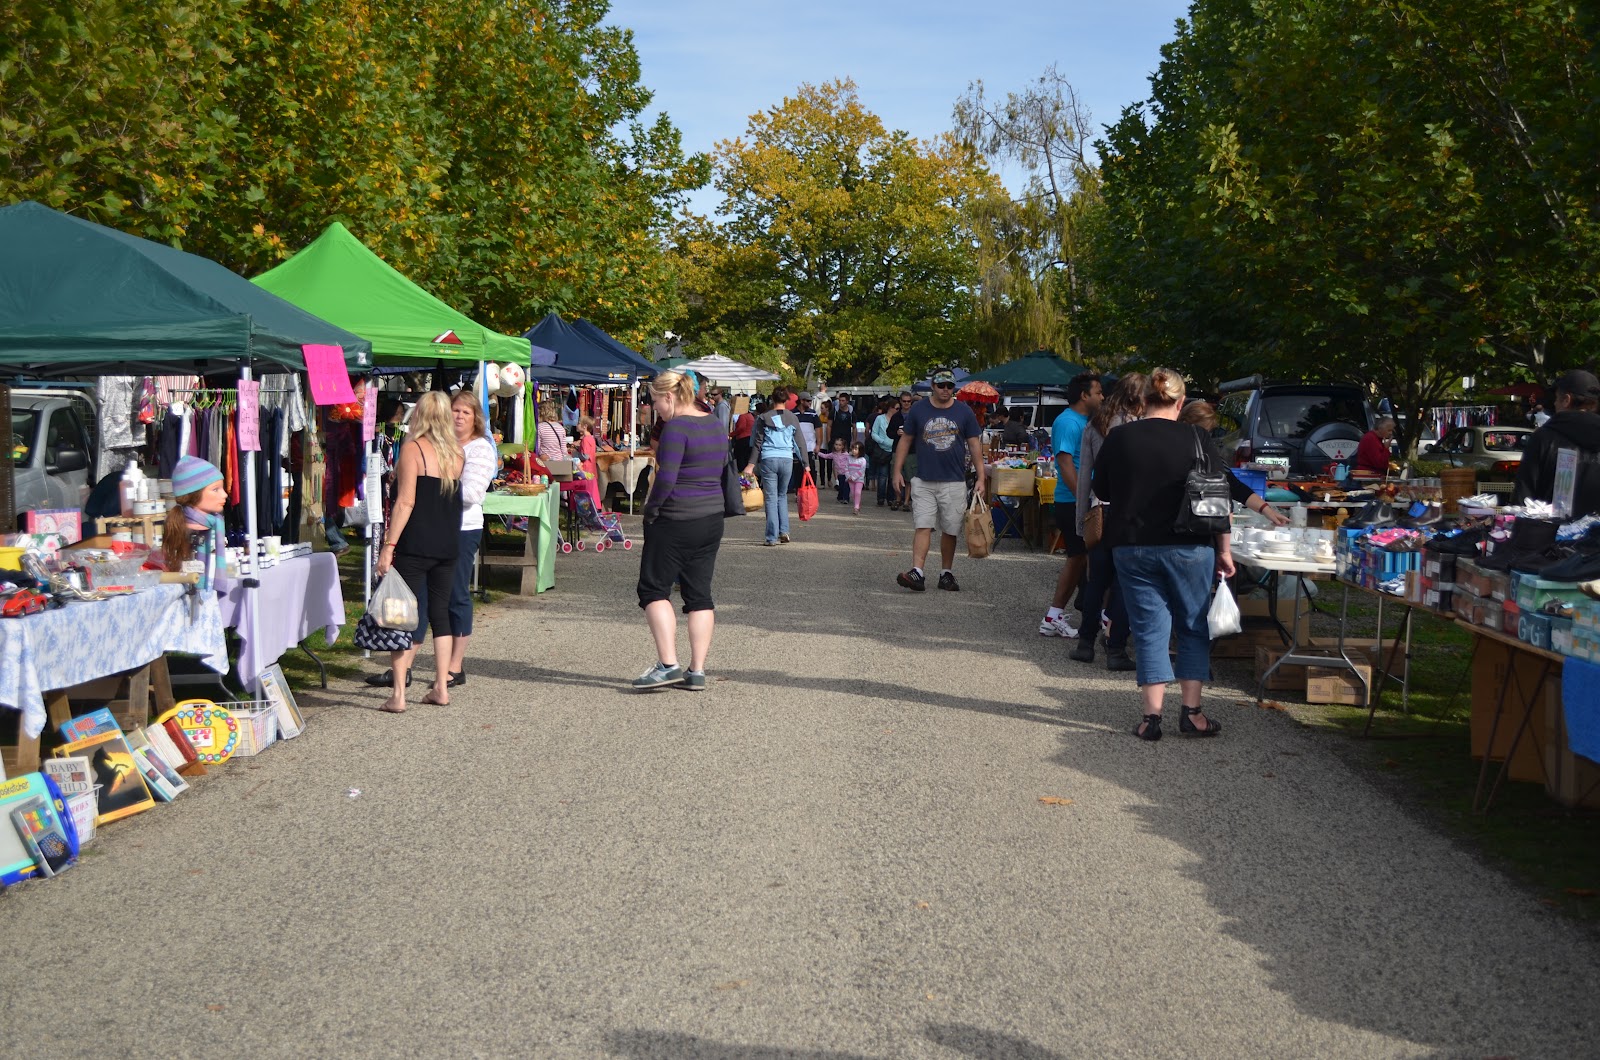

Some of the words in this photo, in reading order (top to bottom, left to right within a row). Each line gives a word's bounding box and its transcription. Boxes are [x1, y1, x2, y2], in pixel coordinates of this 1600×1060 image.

[1320, 441, 1357, 449] PAJERO
[50, 762, 80, 773] BABY
[61, 782, 88, 793] HILD
